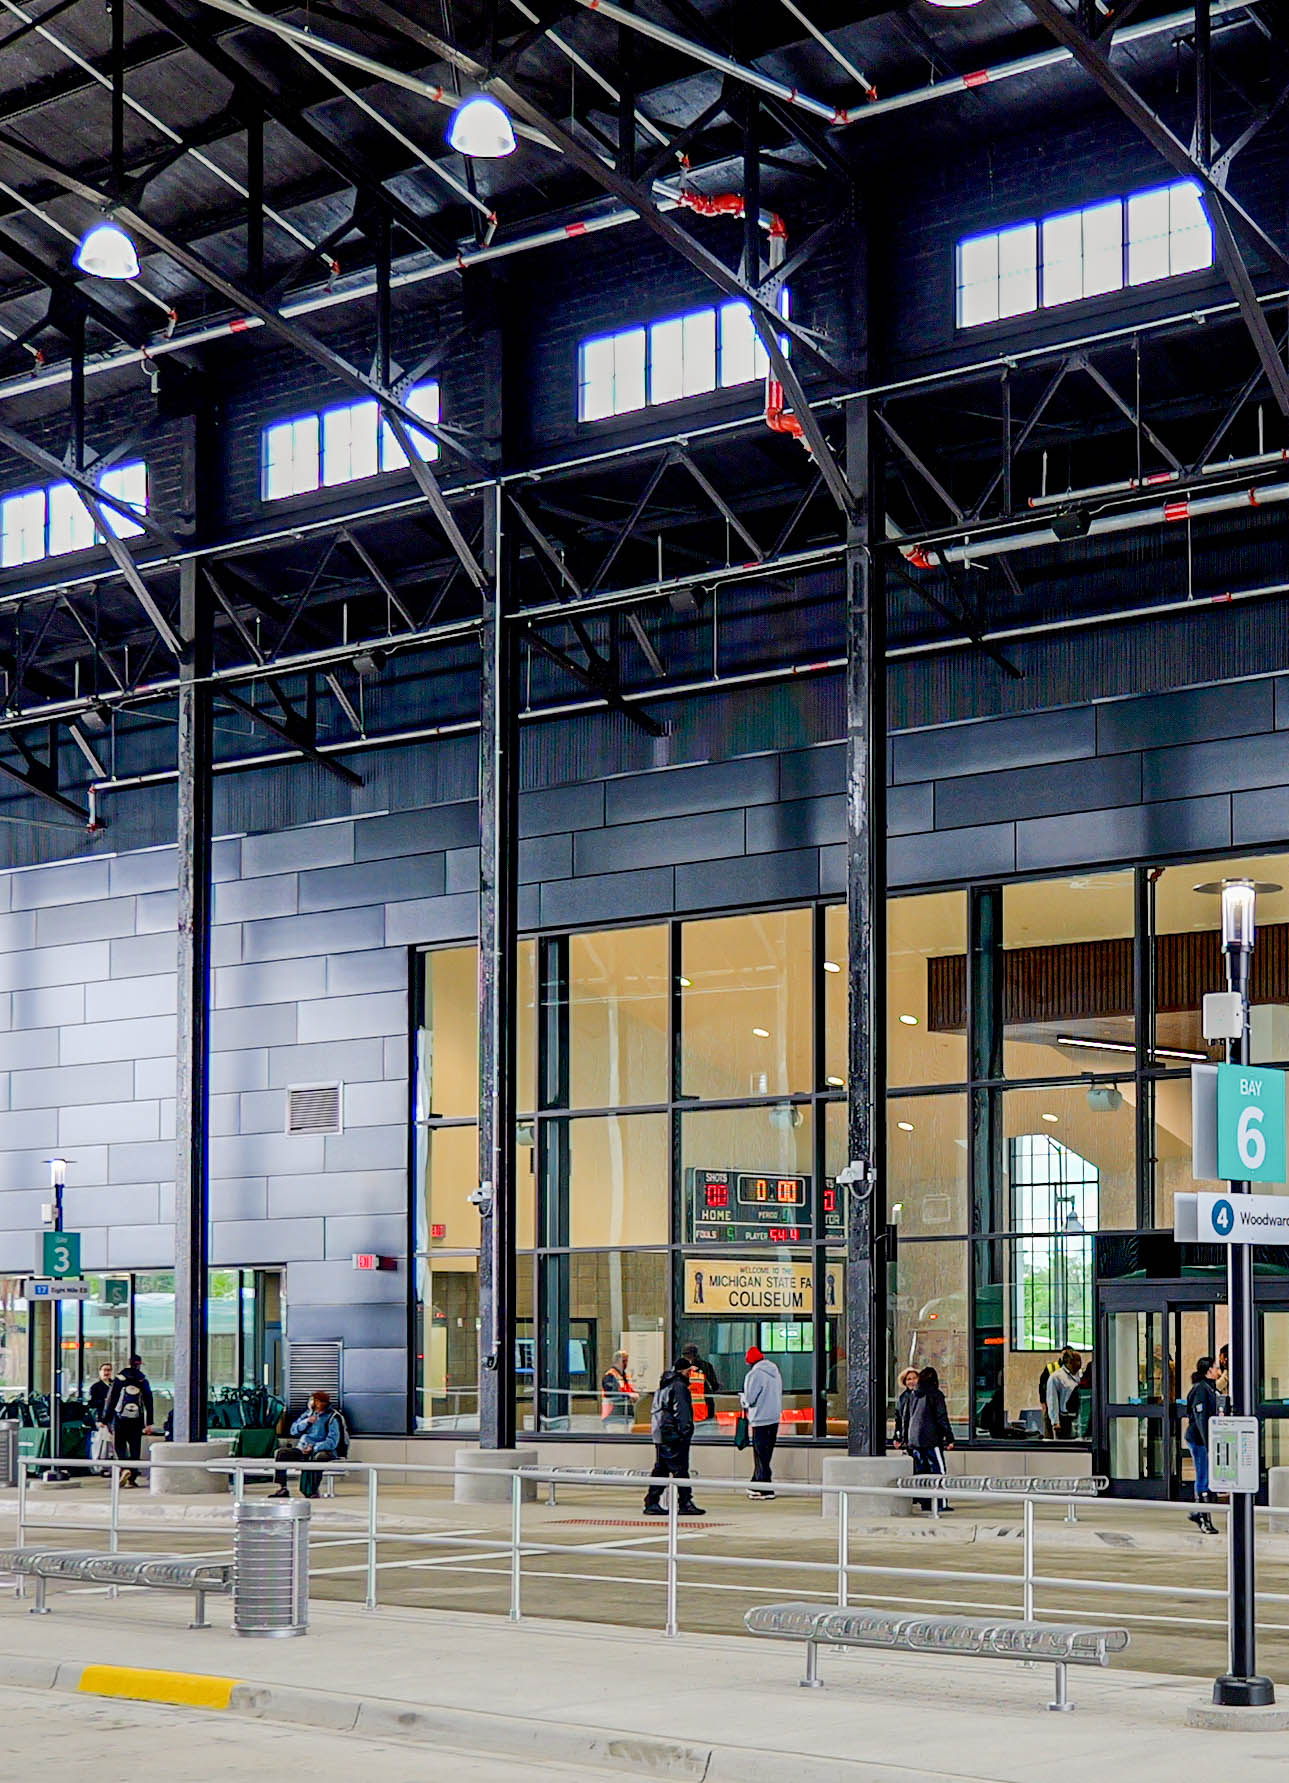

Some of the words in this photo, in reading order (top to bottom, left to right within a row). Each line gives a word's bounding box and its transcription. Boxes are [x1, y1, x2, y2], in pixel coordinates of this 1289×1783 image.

[1239, 1078, 1263, 1097] BAY
[1236, 1105, 1266, 1170] 6
[701, 1209, 732, 1221] HOME
[1216, 1207, 1229, 1229] 4
[54, 1247, 70, 1272] 3
[739, 1266, 769, 1274] WELCOME
[709, 1275, 762, 1288] MICHIGAN
[766, 1276, 797, 1289] STATE
[729, 1291, 803, 1307] COLISEUM
